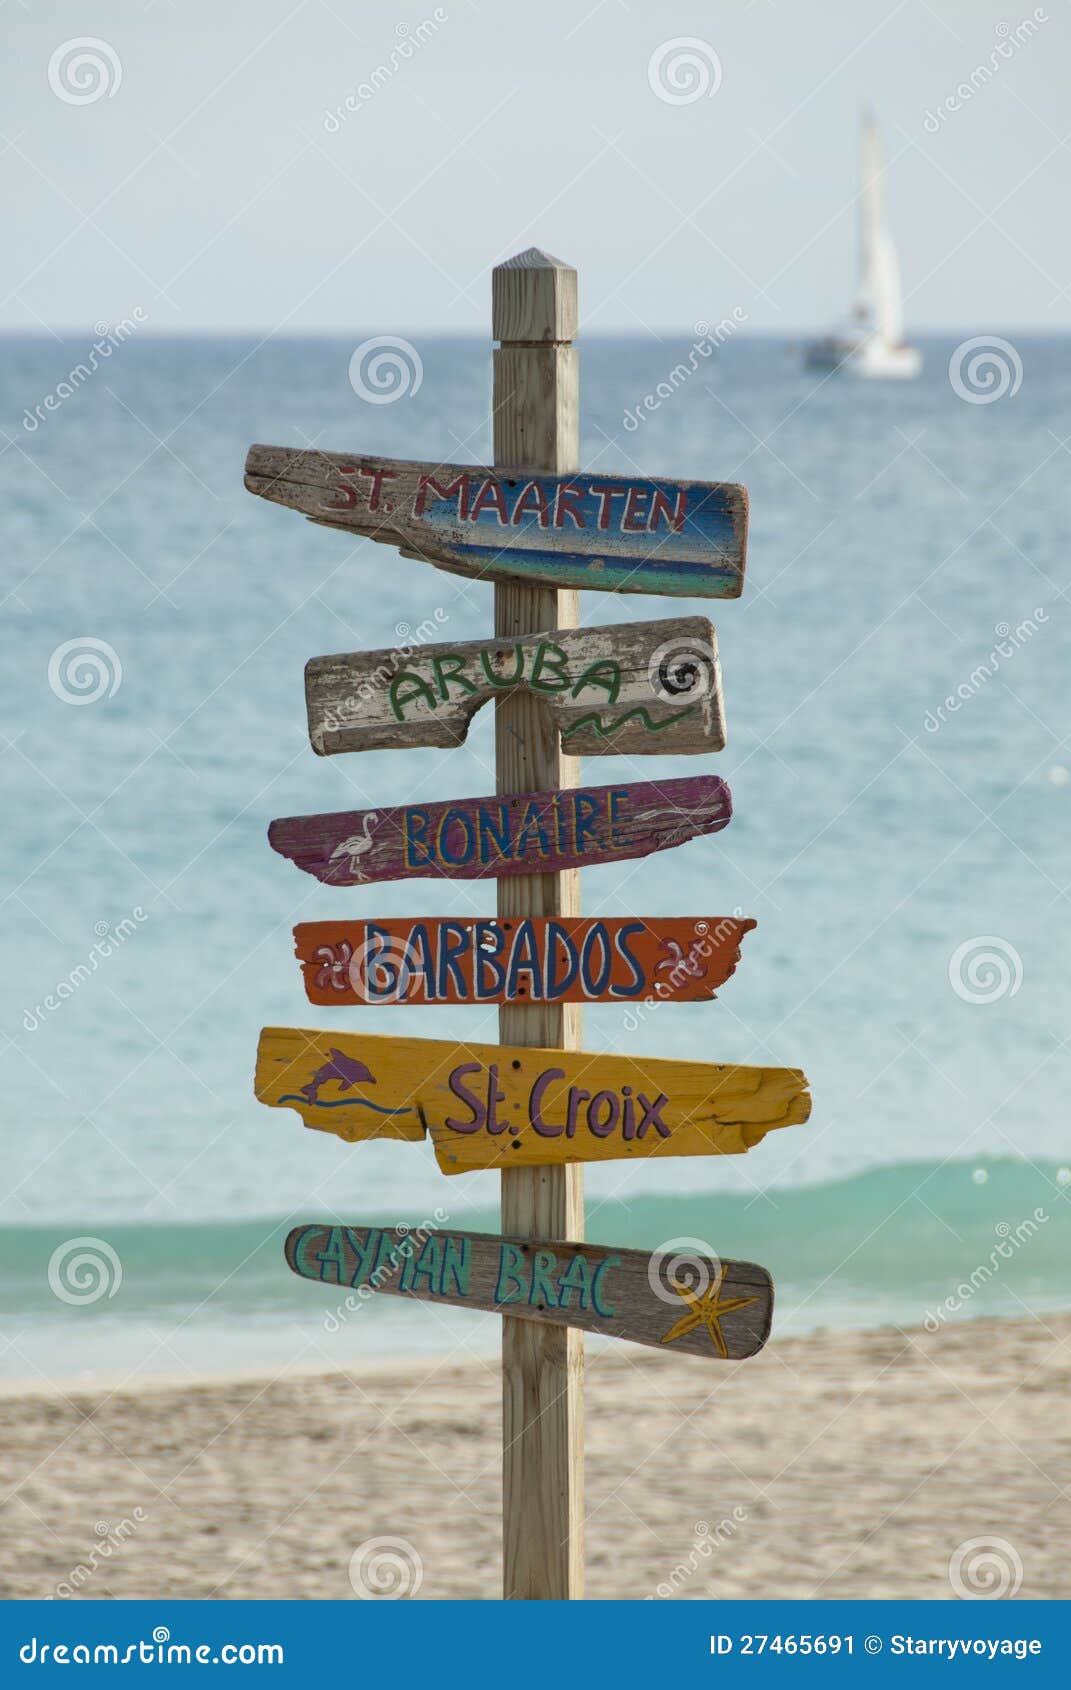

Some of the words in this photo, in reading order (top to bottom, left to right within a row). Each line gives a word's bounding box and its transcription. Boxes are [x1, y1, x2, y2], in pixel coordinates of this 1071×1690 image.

[319, 466, 397, 513] ST.
[411, 473, 687, 534] MAARTEN
[389, 642, 623, 723] ARUBA
[363, 920, 646, 999] BARBADOS
[445, 1062, 519, 1137] St.
[529, 1067, 672, 1141] Croix
[293, 1226, 472, 1297] CAYMAN
[495, 1242, 622, 1318] BRAC
